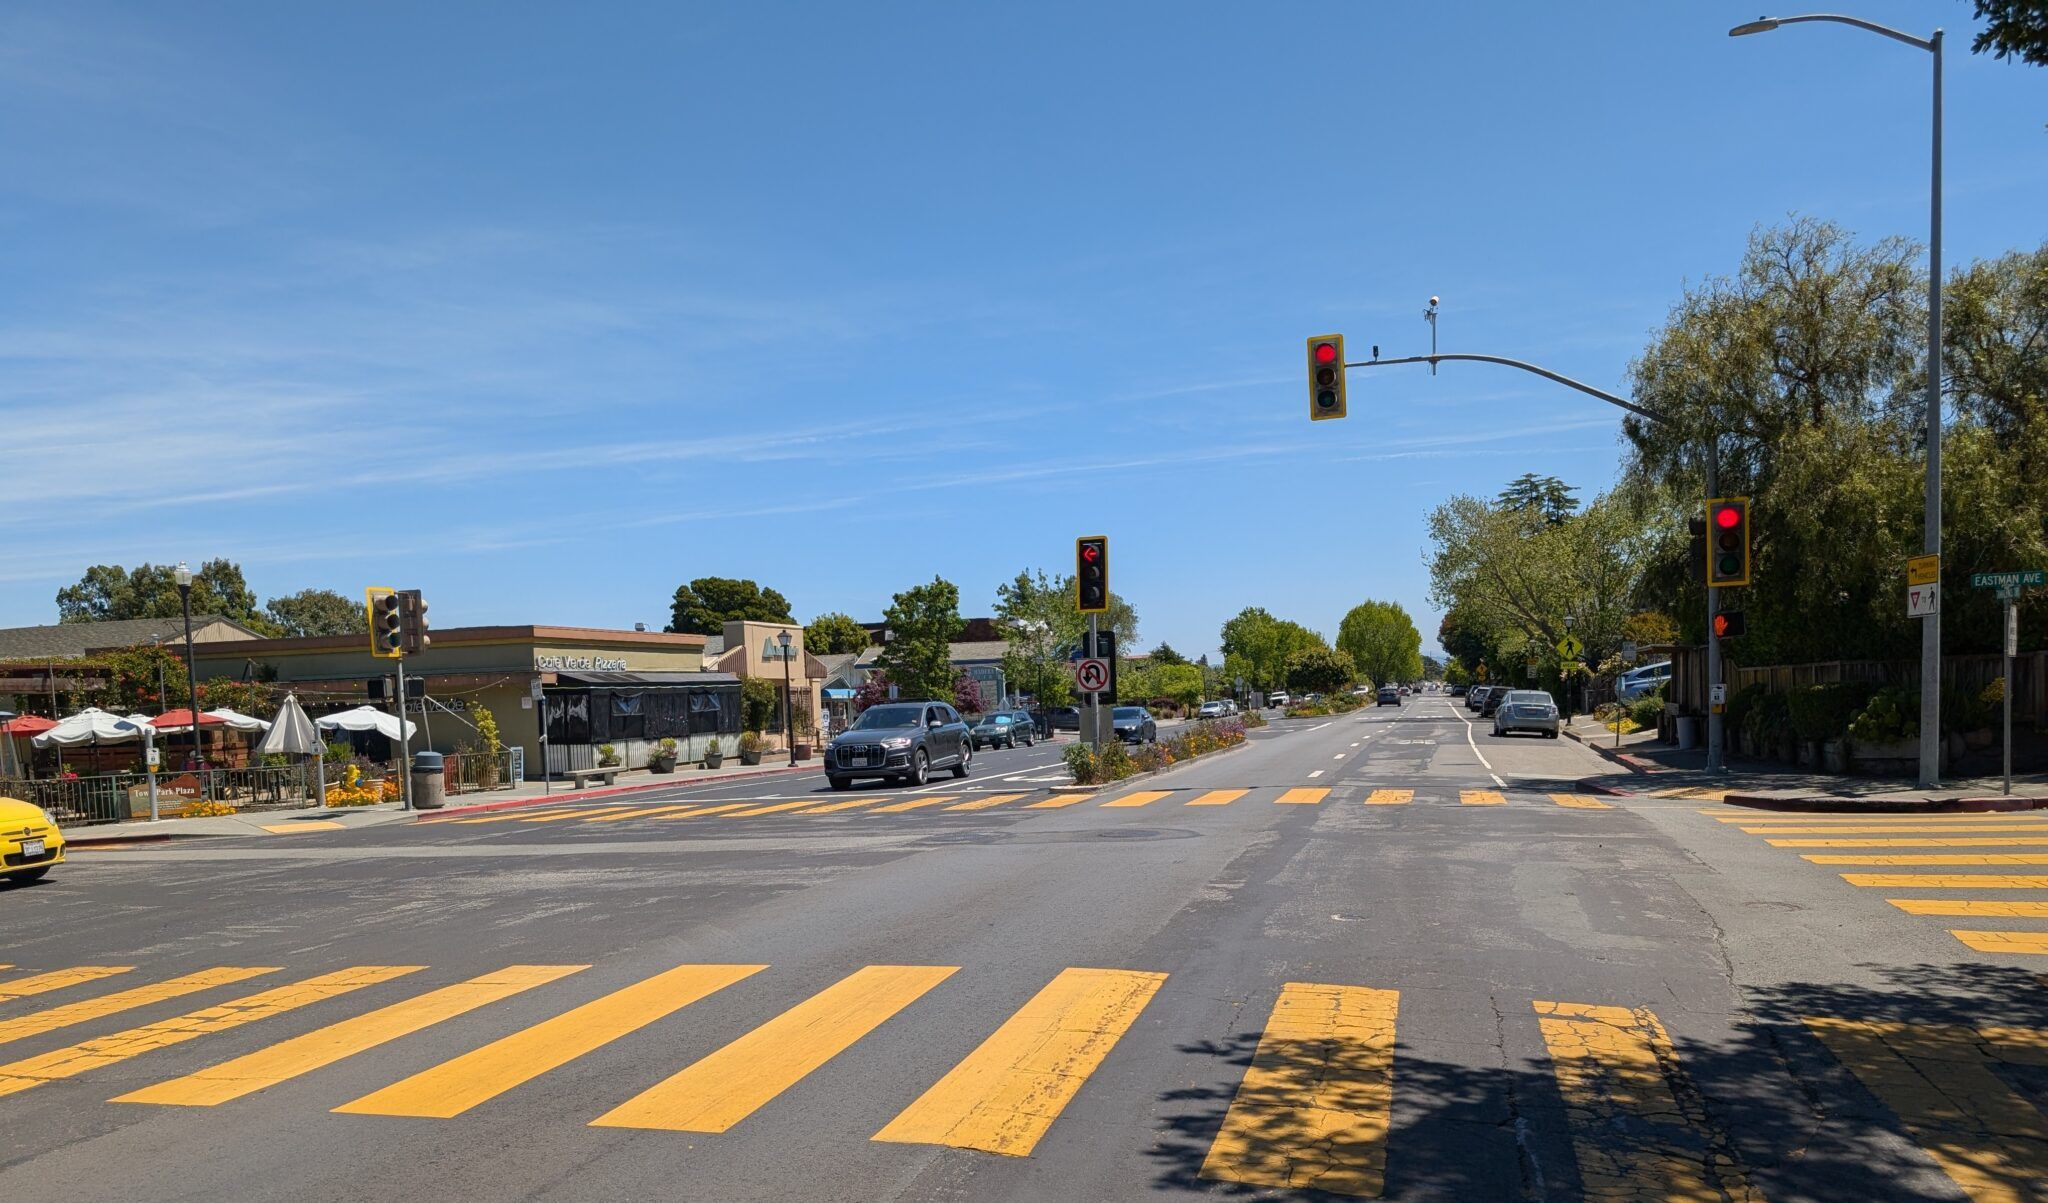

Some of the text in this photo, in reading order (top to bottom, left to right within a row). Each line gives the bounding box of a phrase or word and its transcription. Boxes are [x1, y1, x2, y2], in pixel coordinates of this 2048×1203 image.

[1975, 573, 2041, 587] EASTMAN AVE
[564, 655, 591, 670] Verde
[595, 656, 627, 671] Pizzeria
[428, 698, 464, 712] Verde
[134, 787, 195, 798] Tow Park Plaza
